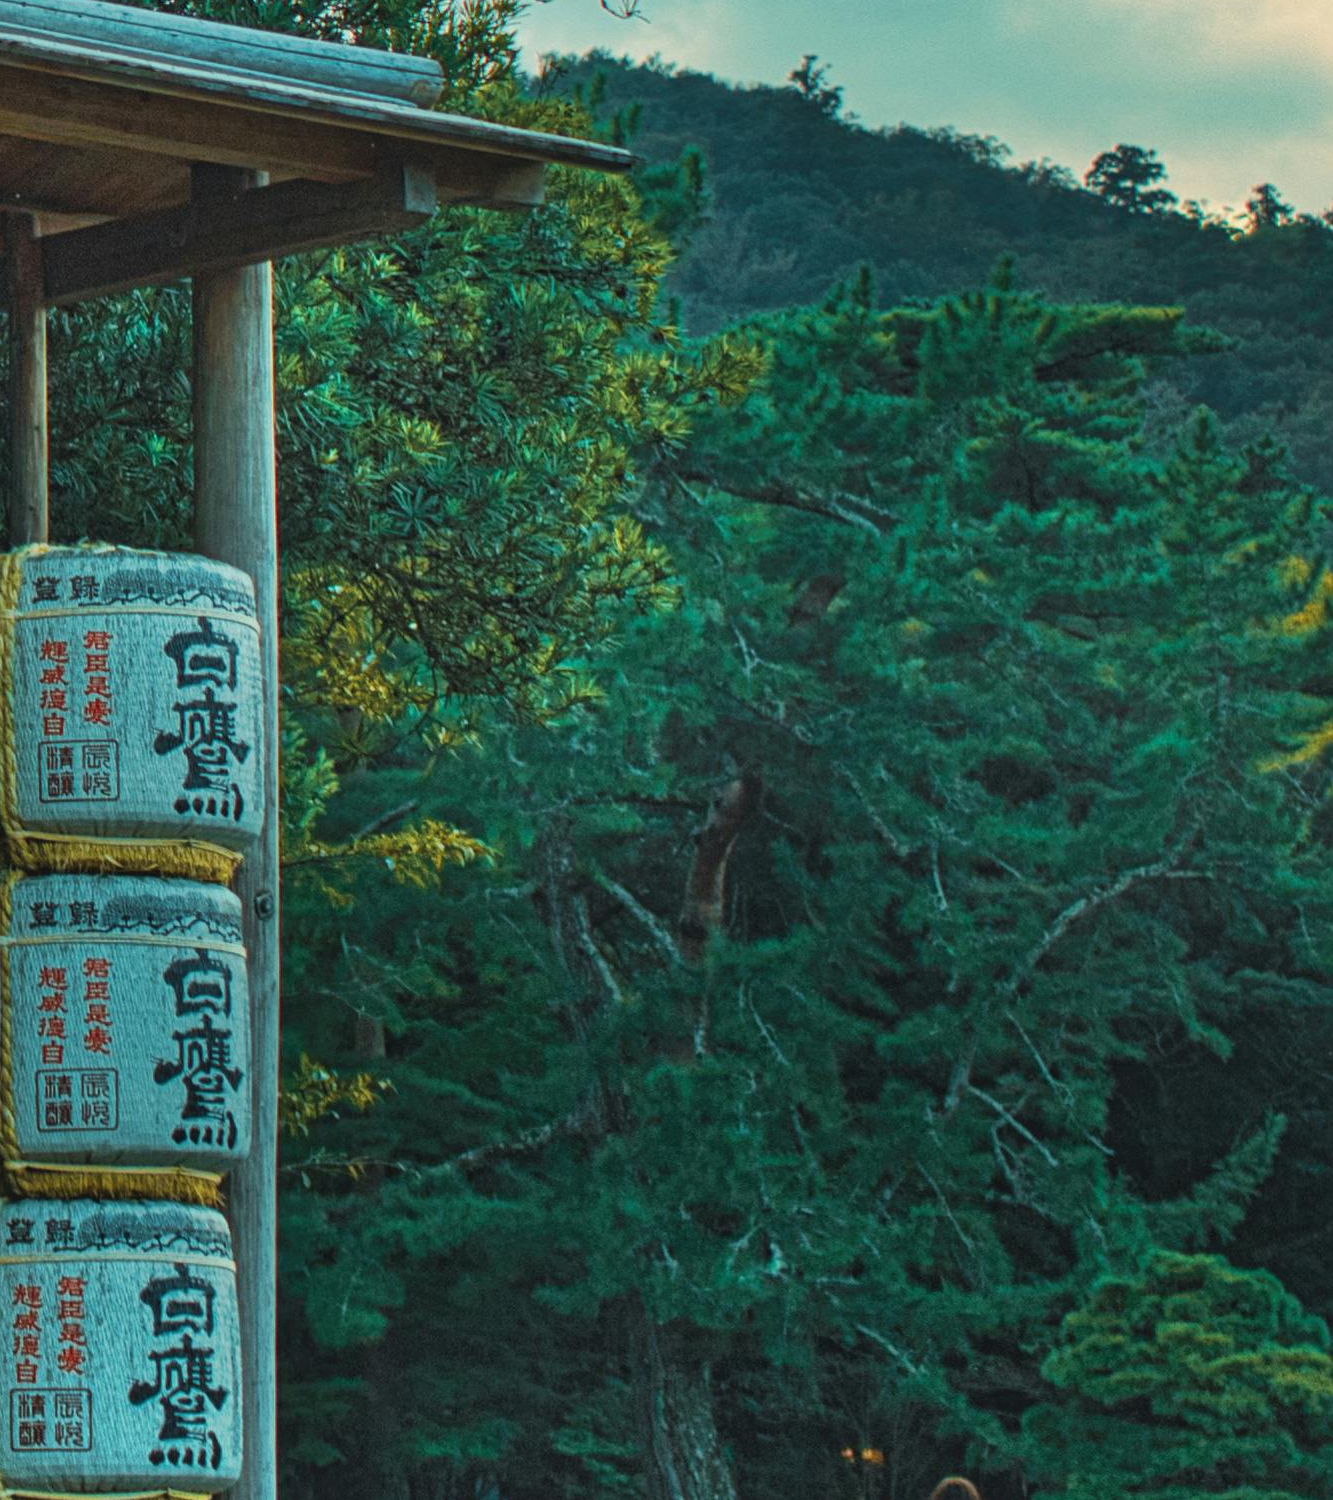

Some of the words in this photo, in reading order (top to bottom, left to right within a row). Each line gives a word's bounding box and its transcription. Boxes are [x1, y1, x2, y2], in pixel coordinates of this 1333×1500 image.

[154, 617, 248, 821] 白鷹
[154, 948, 241, 1149] 白鷹
[129, 1263, 226, 1469] 白鷹
